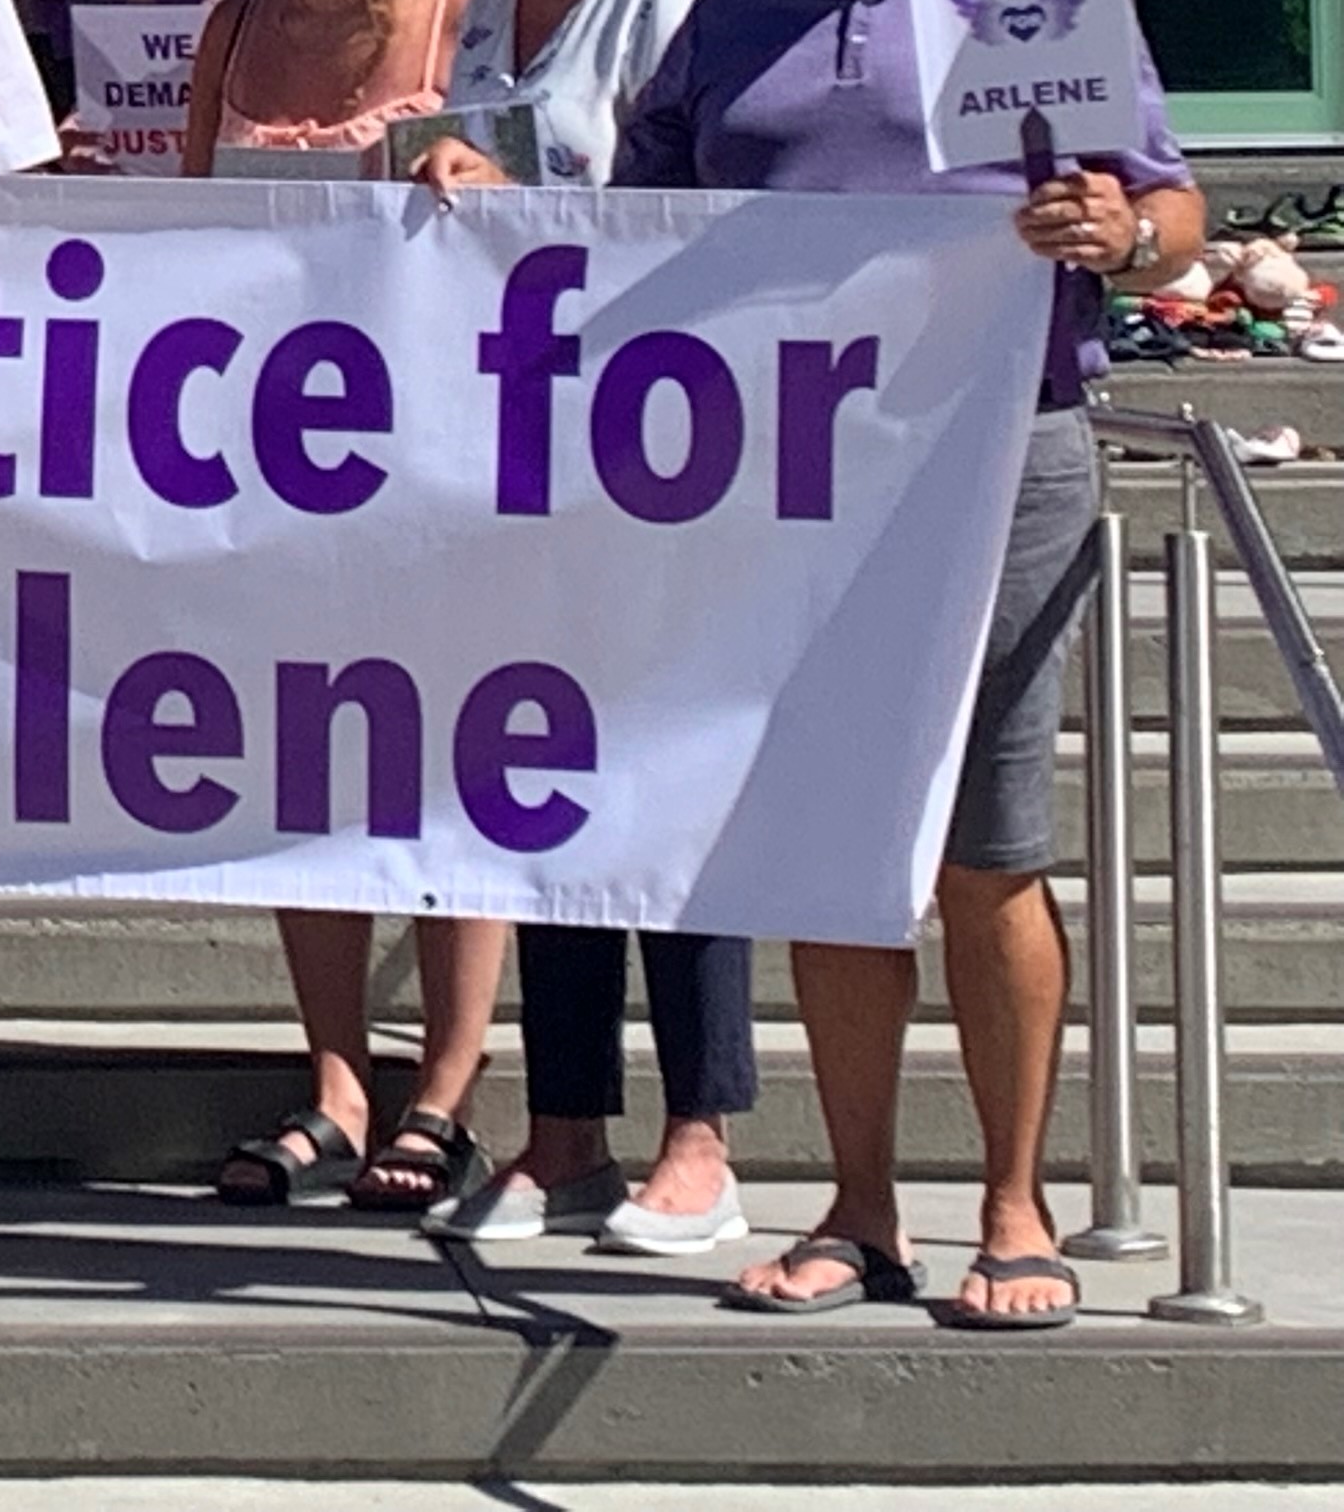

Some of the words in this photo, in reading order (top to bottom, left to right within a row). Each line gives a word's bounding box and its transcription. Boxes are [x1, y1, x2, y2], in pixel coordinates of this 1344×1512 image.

[142, 34, 195, 60] WE
[105, 81, 192, 107] DEMA
[959, 77, 1108, 117] ARLENE
[103, 129, 187, 154] JUST
[477, 243, 881, 525] for
